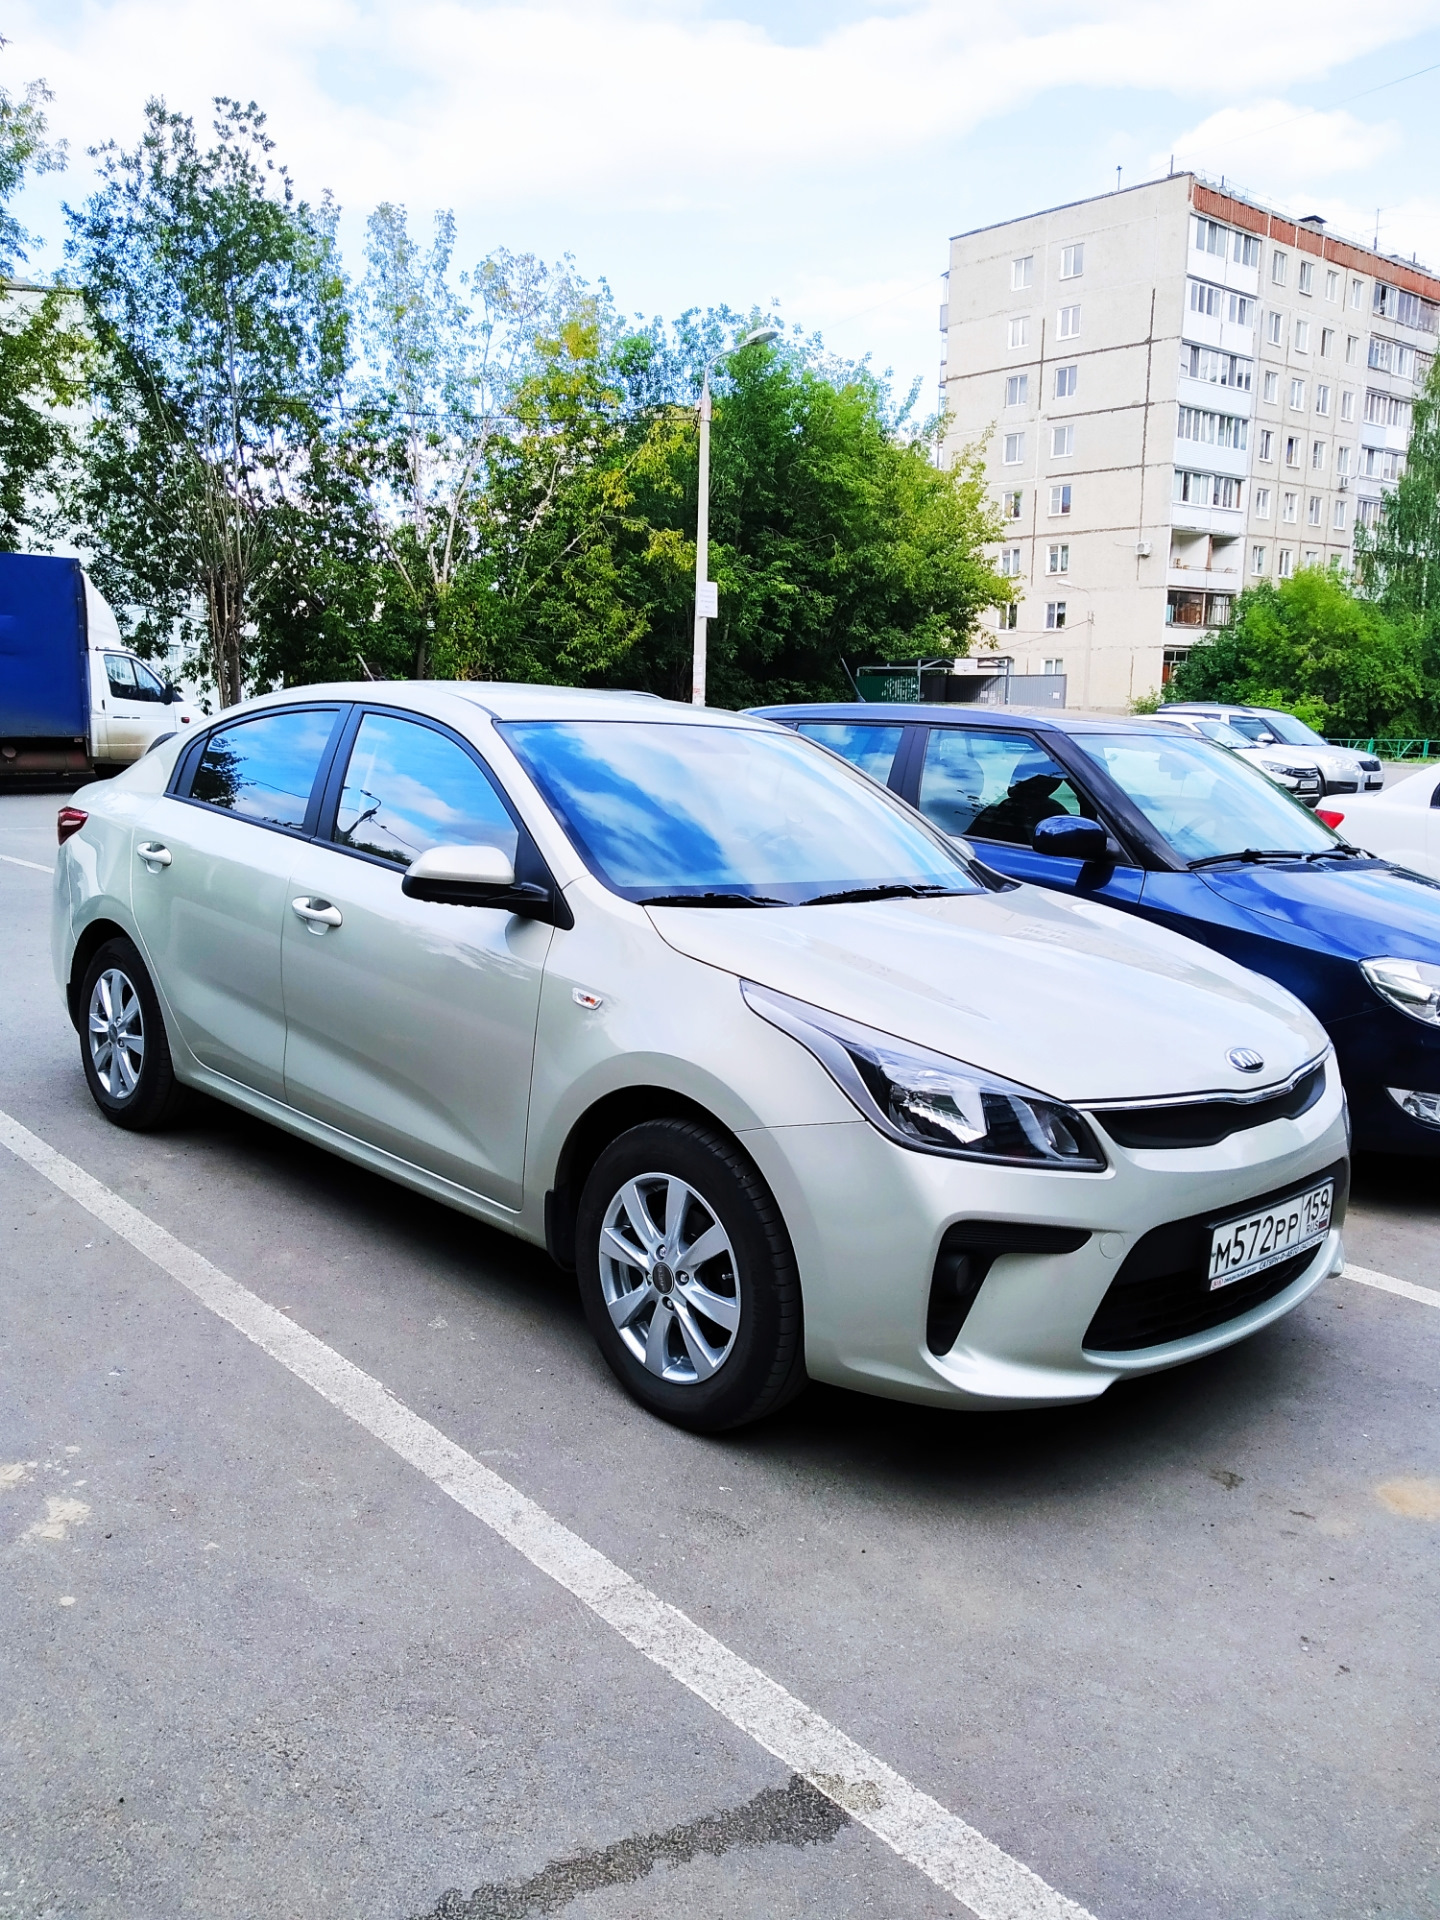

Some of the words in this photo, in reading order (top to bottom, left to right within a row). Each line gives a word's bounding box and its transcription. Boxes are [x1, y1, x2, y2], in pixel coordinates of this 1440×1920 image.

[1231, 1049, 1263, 1068] KIA
[1304, 1188, 1329, 1224] 159
[1306, 1220, 1319, 1235] RUS
